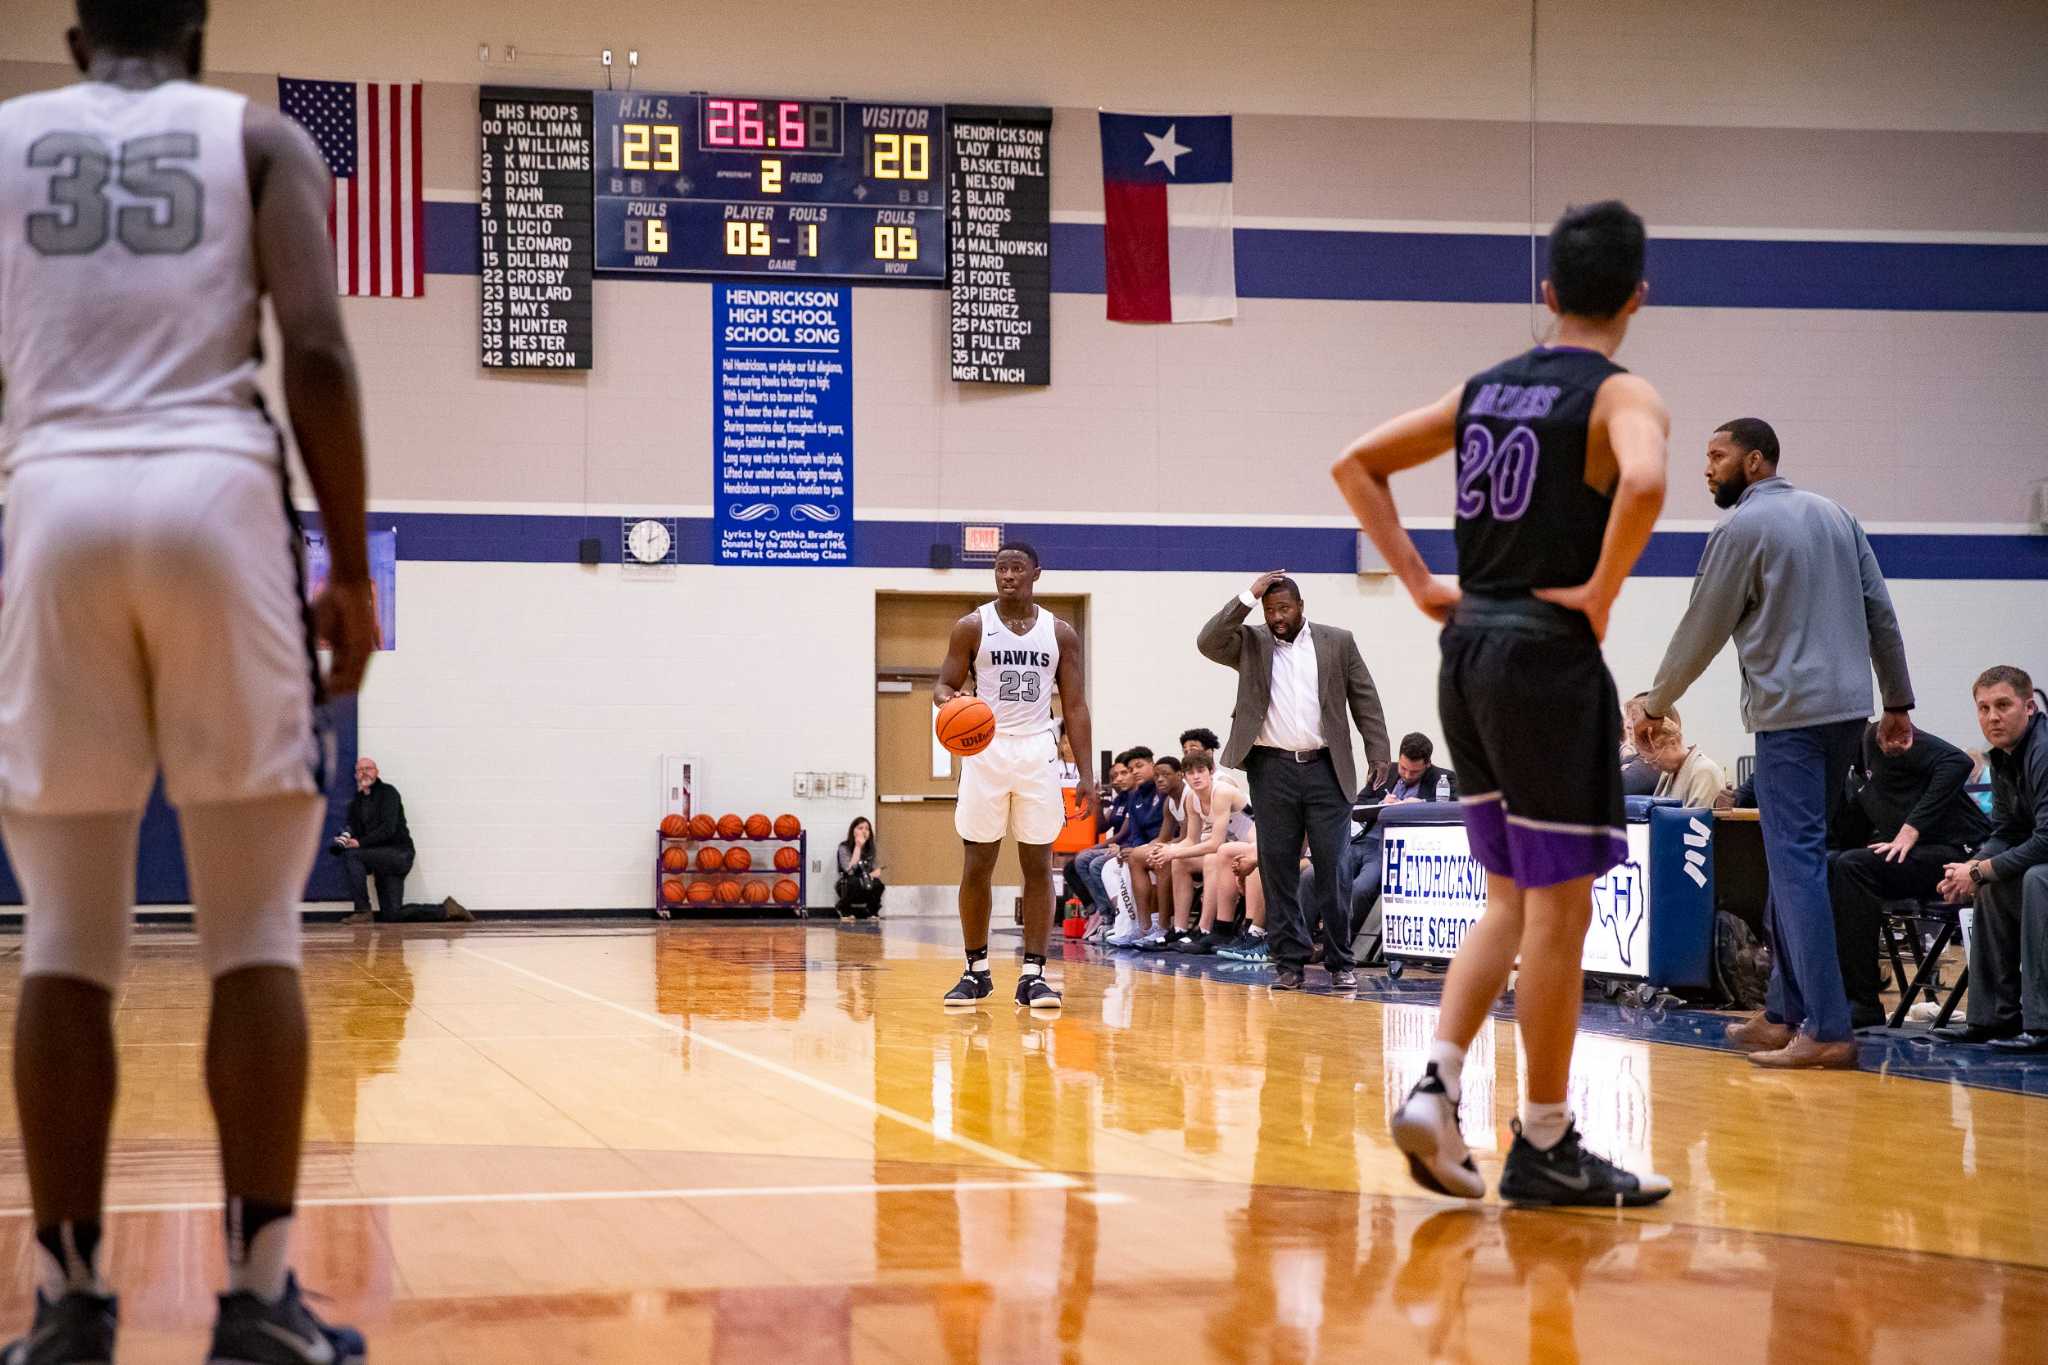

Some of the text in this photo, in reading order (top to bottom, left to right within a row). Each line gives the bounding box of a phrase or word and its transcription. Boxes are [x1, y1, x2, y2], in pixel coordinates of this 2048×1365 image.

[496, 104, 578, 121] HHS HOOPS
[618, 98, 673, 120] H.H.S.
[708, 100, 805, 148] 26.6
[862, 107, 929, 128] VISITOR
[482, 120, 582, 136] 00 HOLLIMAN
[954, 124, 1044, 145] HENDRICKSON
[482, 137, 590, 154] 1 J WILLIAMS
[623, 124, 680, 171] 23
[957, 141, 1041, 160] LADY HAWKS
[482, 154, 590, 170] 2 K WILLIAMS
[874, 134, 929, 180] 20
[960, 158, 1044, 176] BASKETBALL
[482, 170, 539, 185] 3 DISU
[762, 160, 782, 192] 2
[790, 172, 824, 184] PERIOD
[952, 173, 1015, 191] 1 NELSON
[25, 130, 204, 256] 35
[482, 186, 544, 202] 4 RAHN
[952, 190, 1005, 206] 2 BLAIR
[481, 202, 564, 219] 5 WALKER
[627, 203, 668, 217] FOULS
[724, 206, 828, 222] PLAYER FOULS
[877, 211, 916, 224] FOULS
[952, 205, 1012, 222] 4 WOODS
[482, 219, 552, 235] 10 LUCIO
[952, 222, 1000, 238] 11 PAGE
[482, 236, 572, 252] 11 LEONARD
[648, 220, 668, 253] 6
[726, 222, 818, 258] 05 1
[874, 226, 918, 260] 05
[952, 238, 1048, 256] 14 MALINOWSKI
[482, 252, 569, 269] 15 DULIBAN
[634, 256, 658, 267] WON
[768, 260, 796, 271] GAME
[884, 263, 908, 274] WON
[952, 254, 1004, 270] 15 WARD
[482, 269, 564, 284] 22 CROSBY
[952, 270, 1011, 286] 21 FOOTE
[484, 286, 572, 301] 23 BULLARD
[726, 290, 838, 307] HENDRICKSON
[952, 286, 1016, 302] 23 PIERCE
[482, 302, 550, 317] 25 MAYS
[728, 308, 836, 326] HIGH SCHOOL
[952, 302, 1020, 318] 24 SUAREZ
[482, 318, 568, 334] 33 HUNTER
[952, 318, 1032, 335] 25 PASTUCCI
[482, 335, 565, 350] 35 HESTER
[725, 326, 840, 344] SCHOOL SONG
[952, 334, 1021, 350] 31 FULLER
[482, 351, 576, 367] 42 SIMPSON
[952, 350, 1005, 366] 35 LACY
[952, 365, 1025, 383] MGR LYNCH
[1455, 423, 1540, 521] 20
[724, 530, 844, 541] Lyrics by Cynthia Bradley
[722, 540, 753, 549] Donated
[755, 540, 764, 550] by
[766, 540, 778, 549] the
[799, 541, 818, 550] Class
[820, 540, 828, 550] of
[722, 550, 847, 561] the First Graduating Class
[990, 650, 1050, 668] HAWKS
[1000, 670, 1040, 702] 23
[1386, 915, 1476, 949] HIGH SCHO
